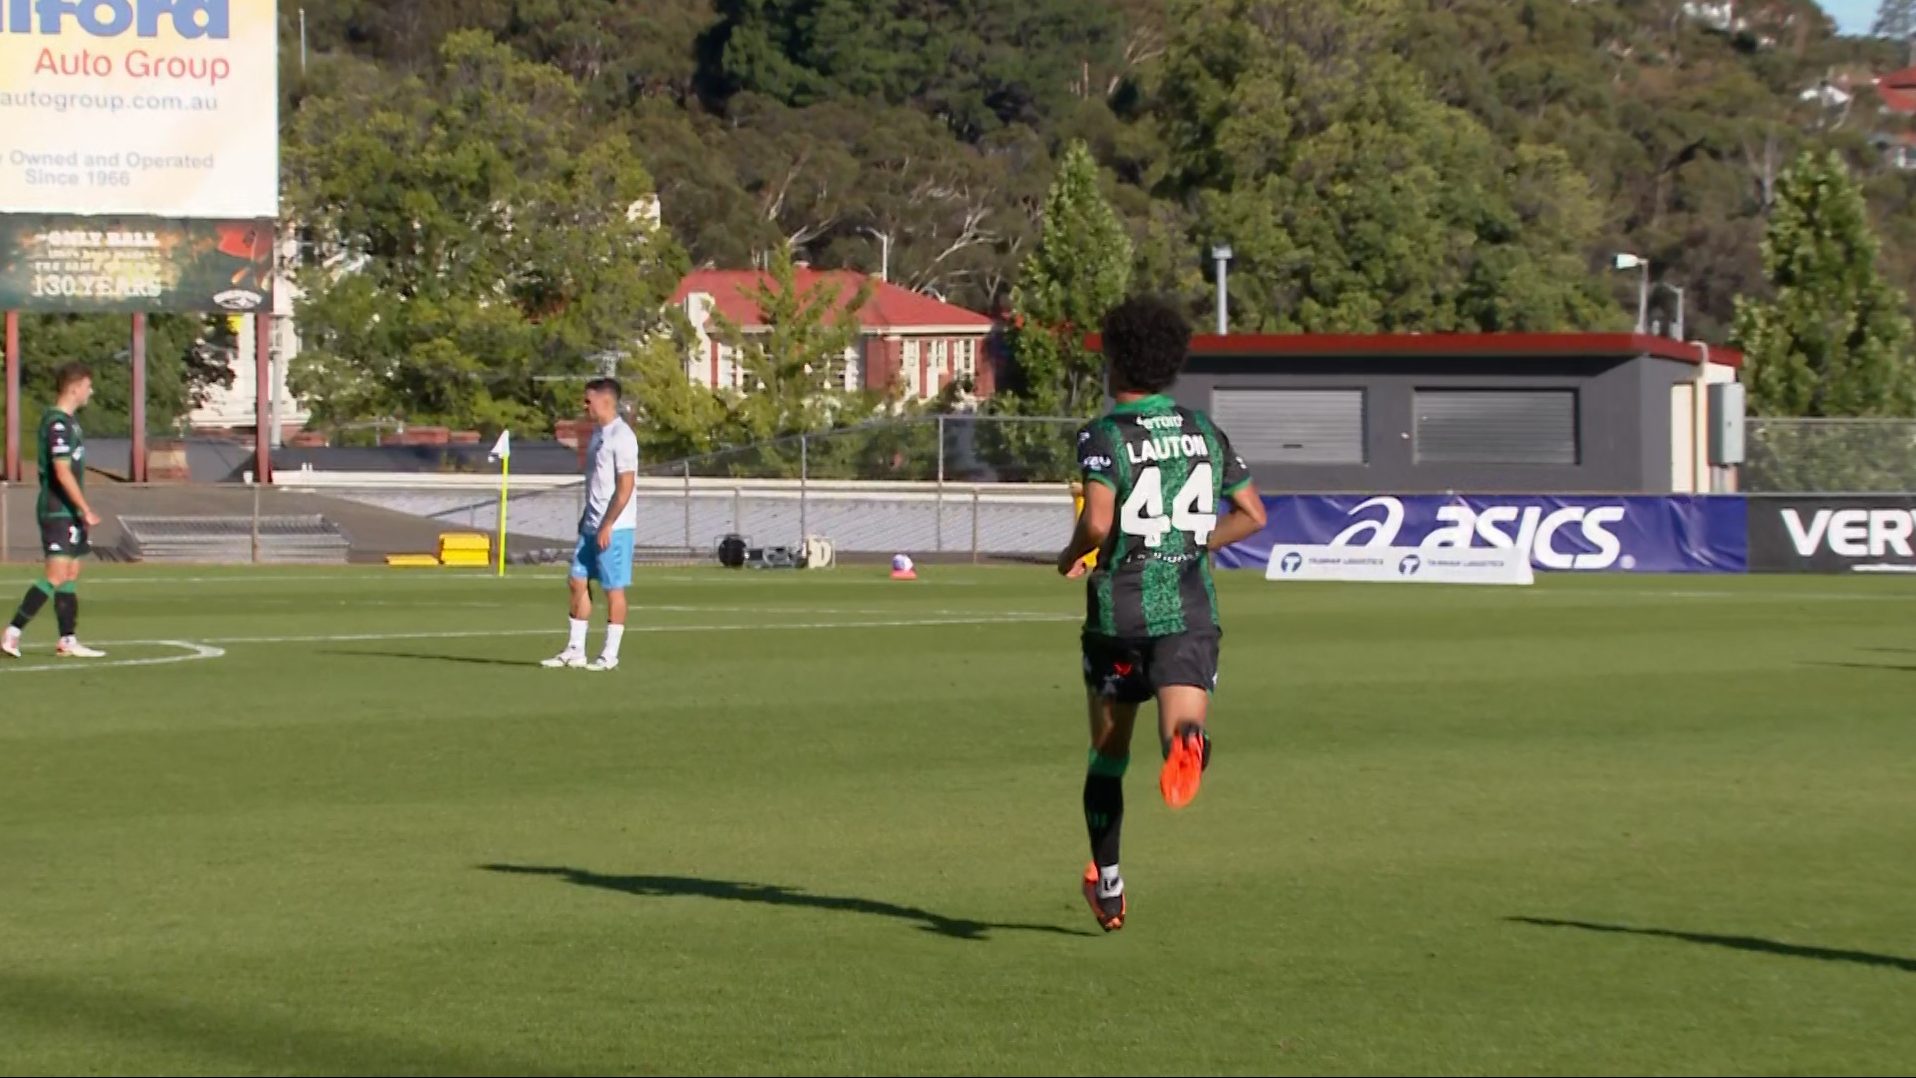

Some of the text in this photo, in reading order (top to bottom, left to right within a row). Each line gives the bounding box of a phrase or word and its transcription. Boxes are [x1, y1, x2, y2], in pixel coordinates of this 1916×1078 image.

[0, 0, 229, 39] lford
[34, 47, 230, 86] Auto Group
[0, 91, 219, 113] autogroup.com.au
[9, 149, 78, 167] Owned
[83, 152, 120, 168] and
[125, 151, 215, 171] Operated
[24, 168, 131, 187] Since 1966
[32, 275, 162, 297] 130 YEARS
[1126, 433, 1209, 464] LAUTON
[1120, 461, 1217, 548] 44
[1780, 509, 1916, 557] VER
